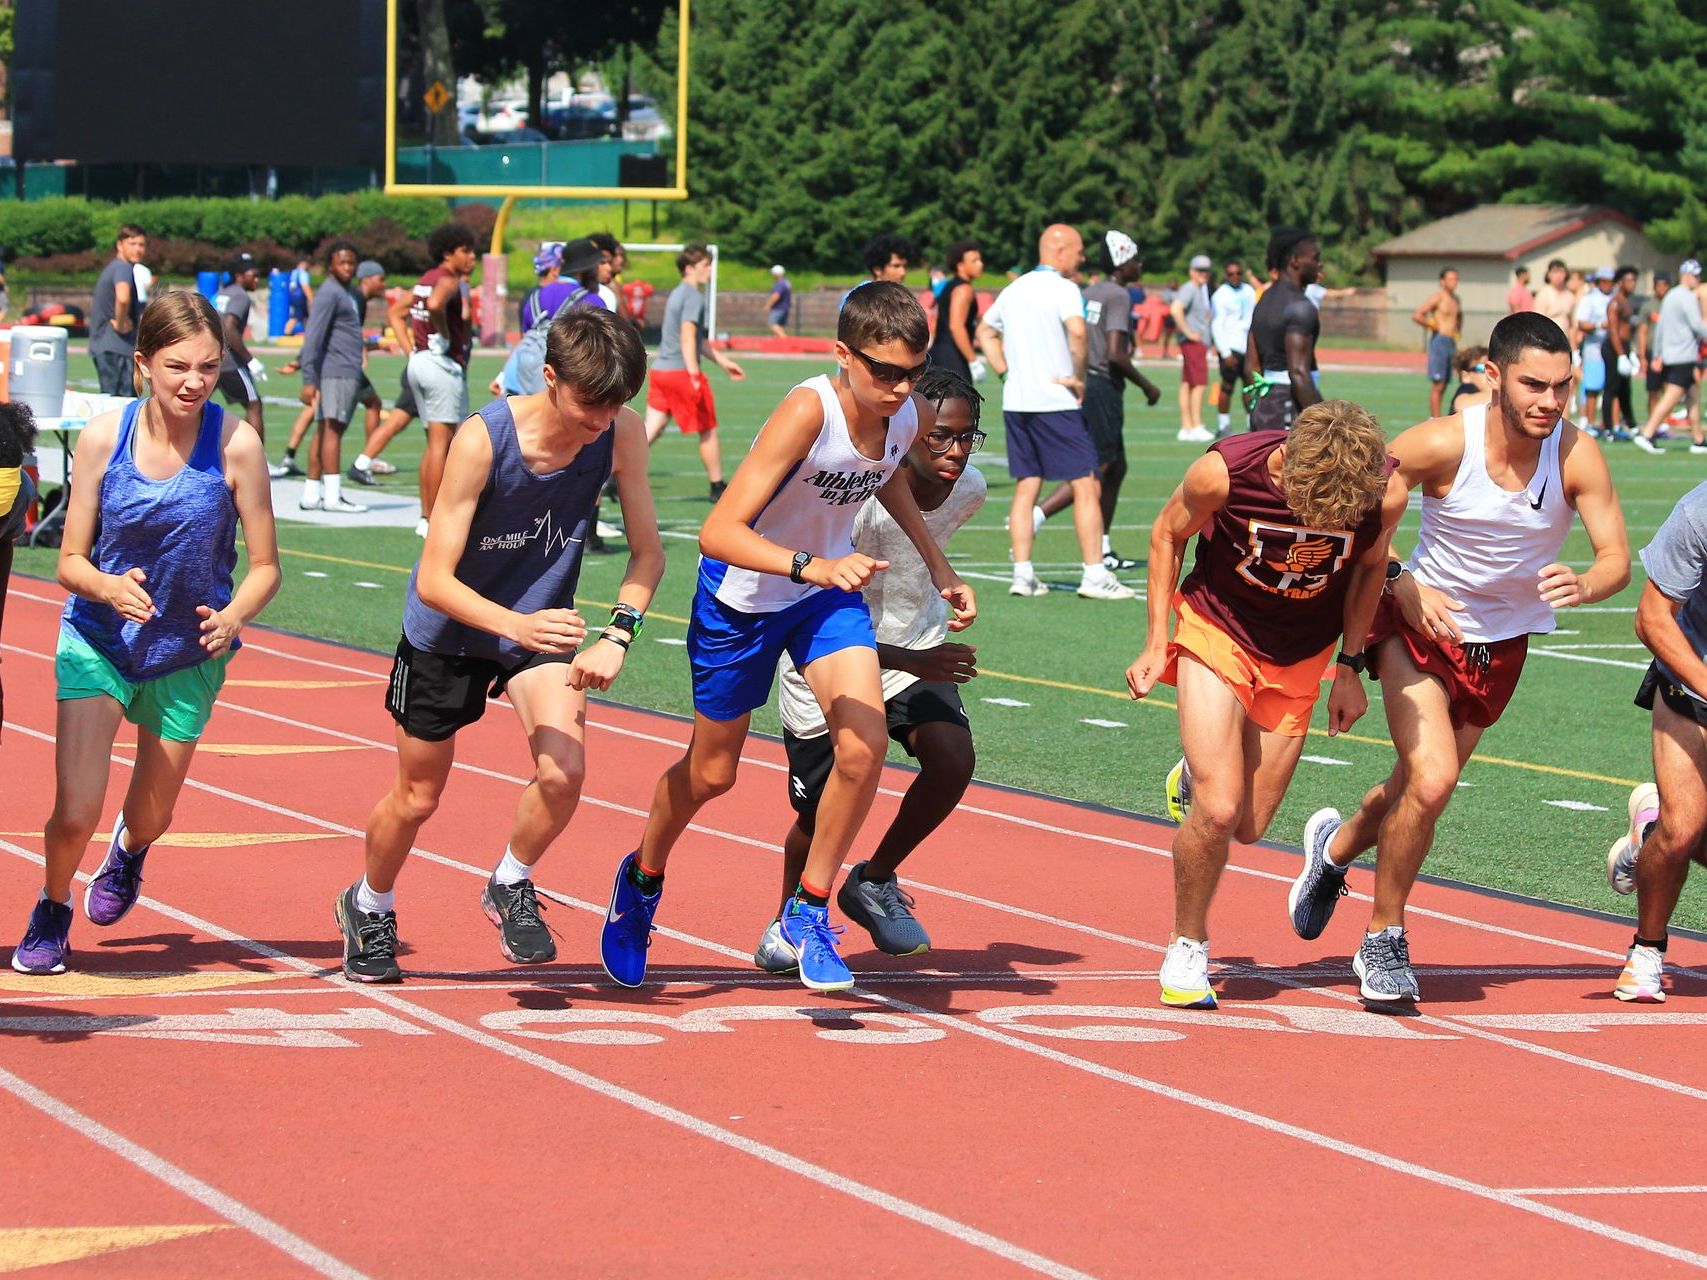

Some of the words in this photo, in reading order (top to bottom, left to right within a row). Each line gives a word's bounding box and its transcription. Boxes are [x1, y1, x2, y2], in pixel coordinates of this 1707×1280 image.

[803, 470, 885, 490] Athletes
[819, 488, 838, 499] in
[827, 484, 881, 505] Acti
[482, 535, 503, 544] ONE
[505, 530, 529, 541] MILE
[497, 540, 526, 549] HOUR
